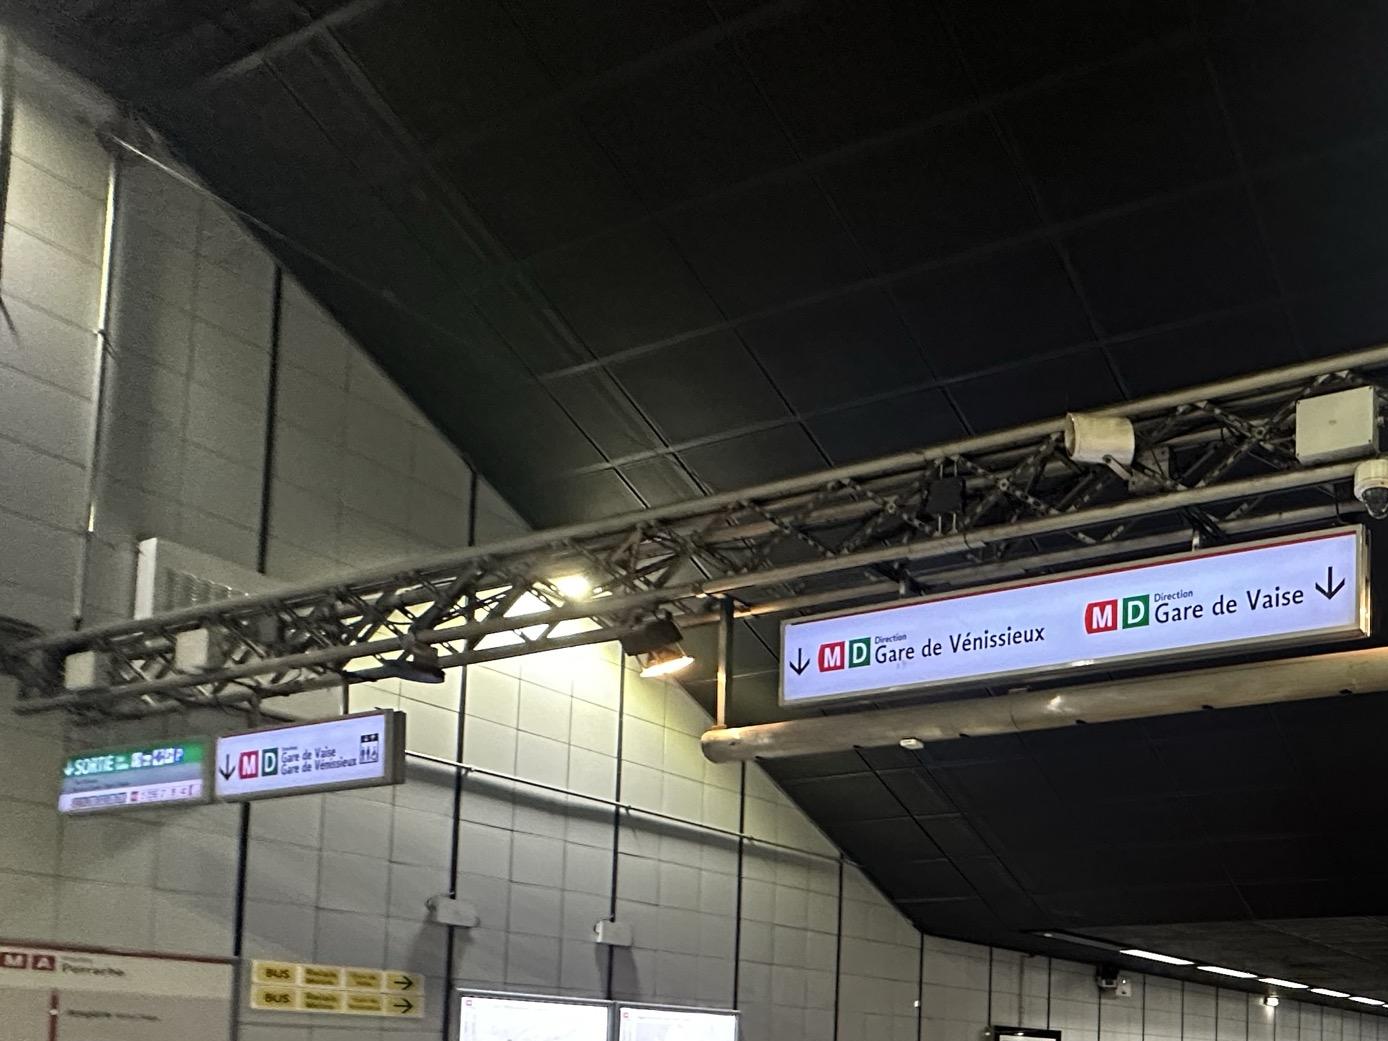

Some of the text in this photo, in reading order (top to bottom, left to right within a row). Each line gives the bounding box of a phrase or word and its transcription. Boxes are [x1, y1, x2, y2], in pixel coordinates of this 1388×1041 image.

[1154, 589, 1193, 603] Direction
[1155, 587, 1304, 624] Gare de Vaise
[874, 632, 907, 645] Direction
[875, 626, 1045, 664] Gare de Vénissieux
[281, 746, 336, 763] Gare de Vaise
[281, 763, 300, 775] Gare
[301, 761, 313, 773] de
[265, 968, 290, 979] BUS
[264, 993, 290, 1004] BUS
